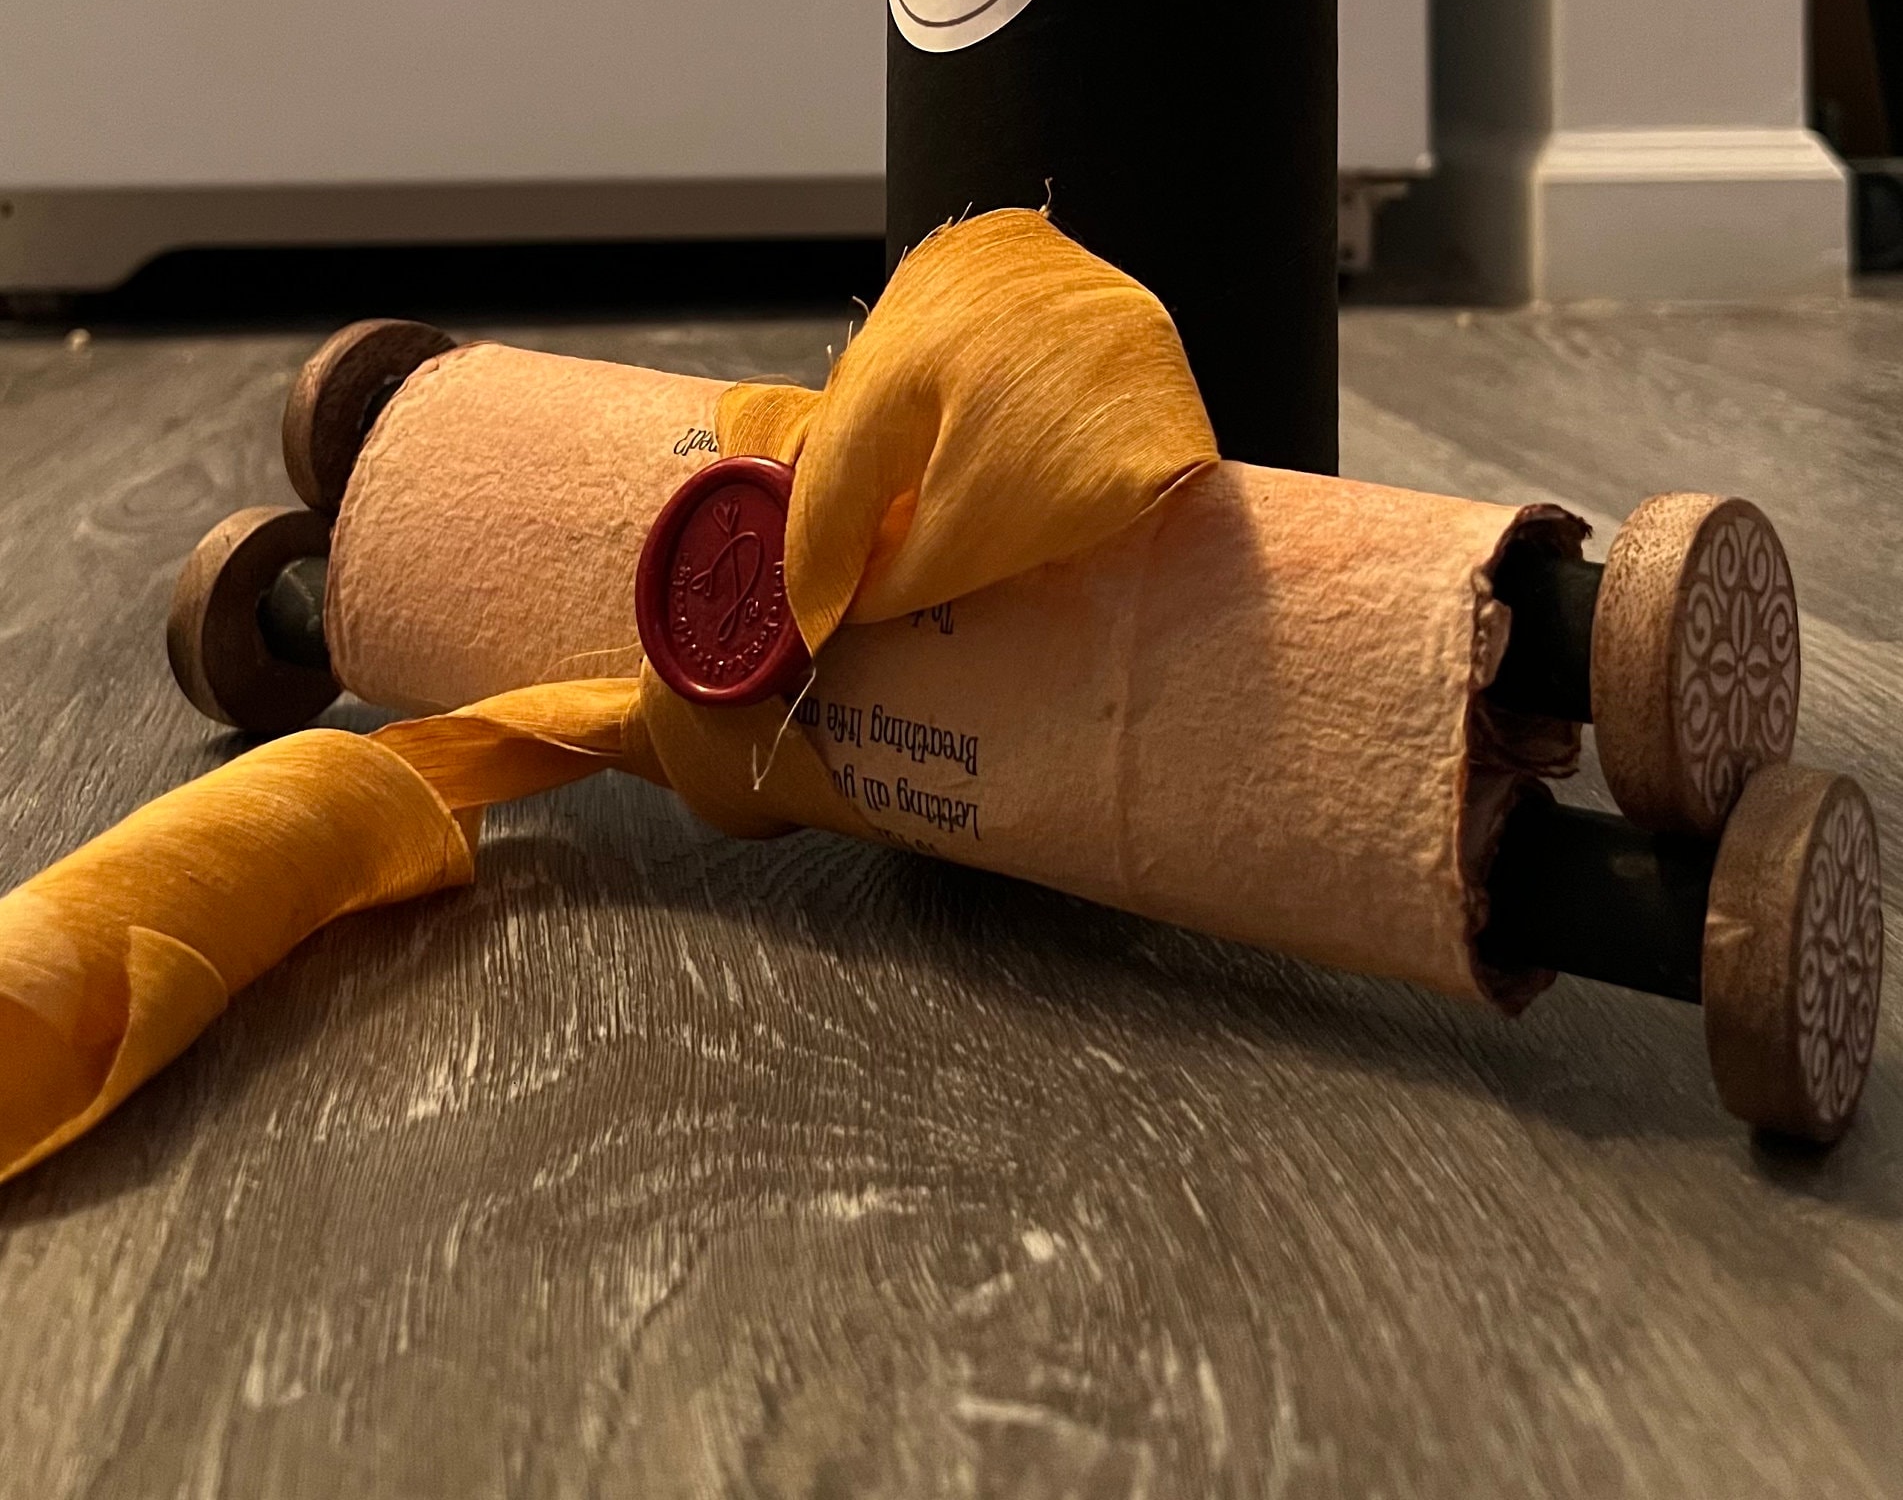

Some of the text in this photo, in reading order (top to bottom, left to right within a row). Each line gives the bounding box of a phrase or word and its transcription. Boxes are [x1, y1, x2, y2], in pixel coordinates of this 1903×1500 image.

[795, 695, 979, 776] Breathing life an
[862, 776, 891, 812] all
[896, 776, 982, 841] Letting
